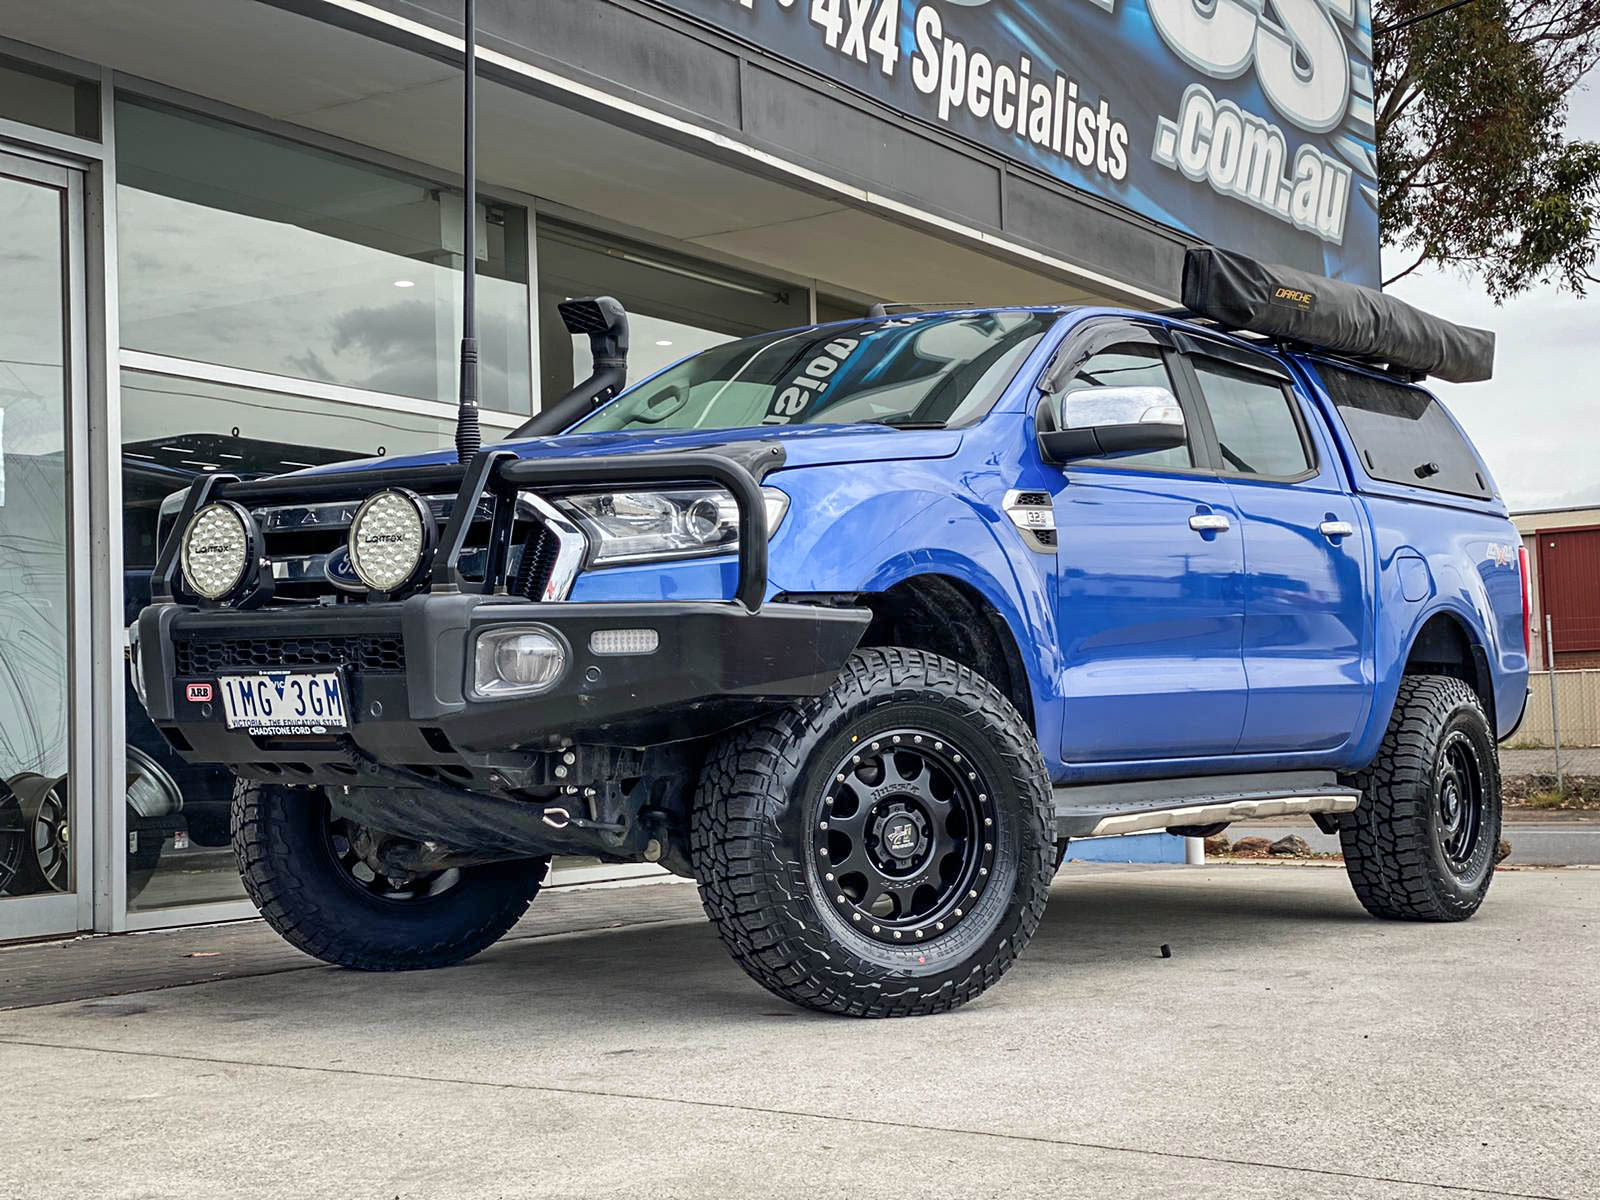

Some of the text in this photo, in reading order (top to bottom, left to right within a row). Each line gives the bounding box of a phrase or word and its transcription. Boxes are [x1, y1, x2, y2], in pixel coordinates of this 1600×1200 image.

[811, 0, 899, 76] 4x4
[911, 5, 1128, 181] Specialists
[1275, 288, 1312, 304] DARCHE
[190, 687, 209, 698] ARB
[226, 678, 343, 717] 1MG 3GM
[248, 726, 290, 736] CHADSTONE
[291, 725, 312, 735] FORD
